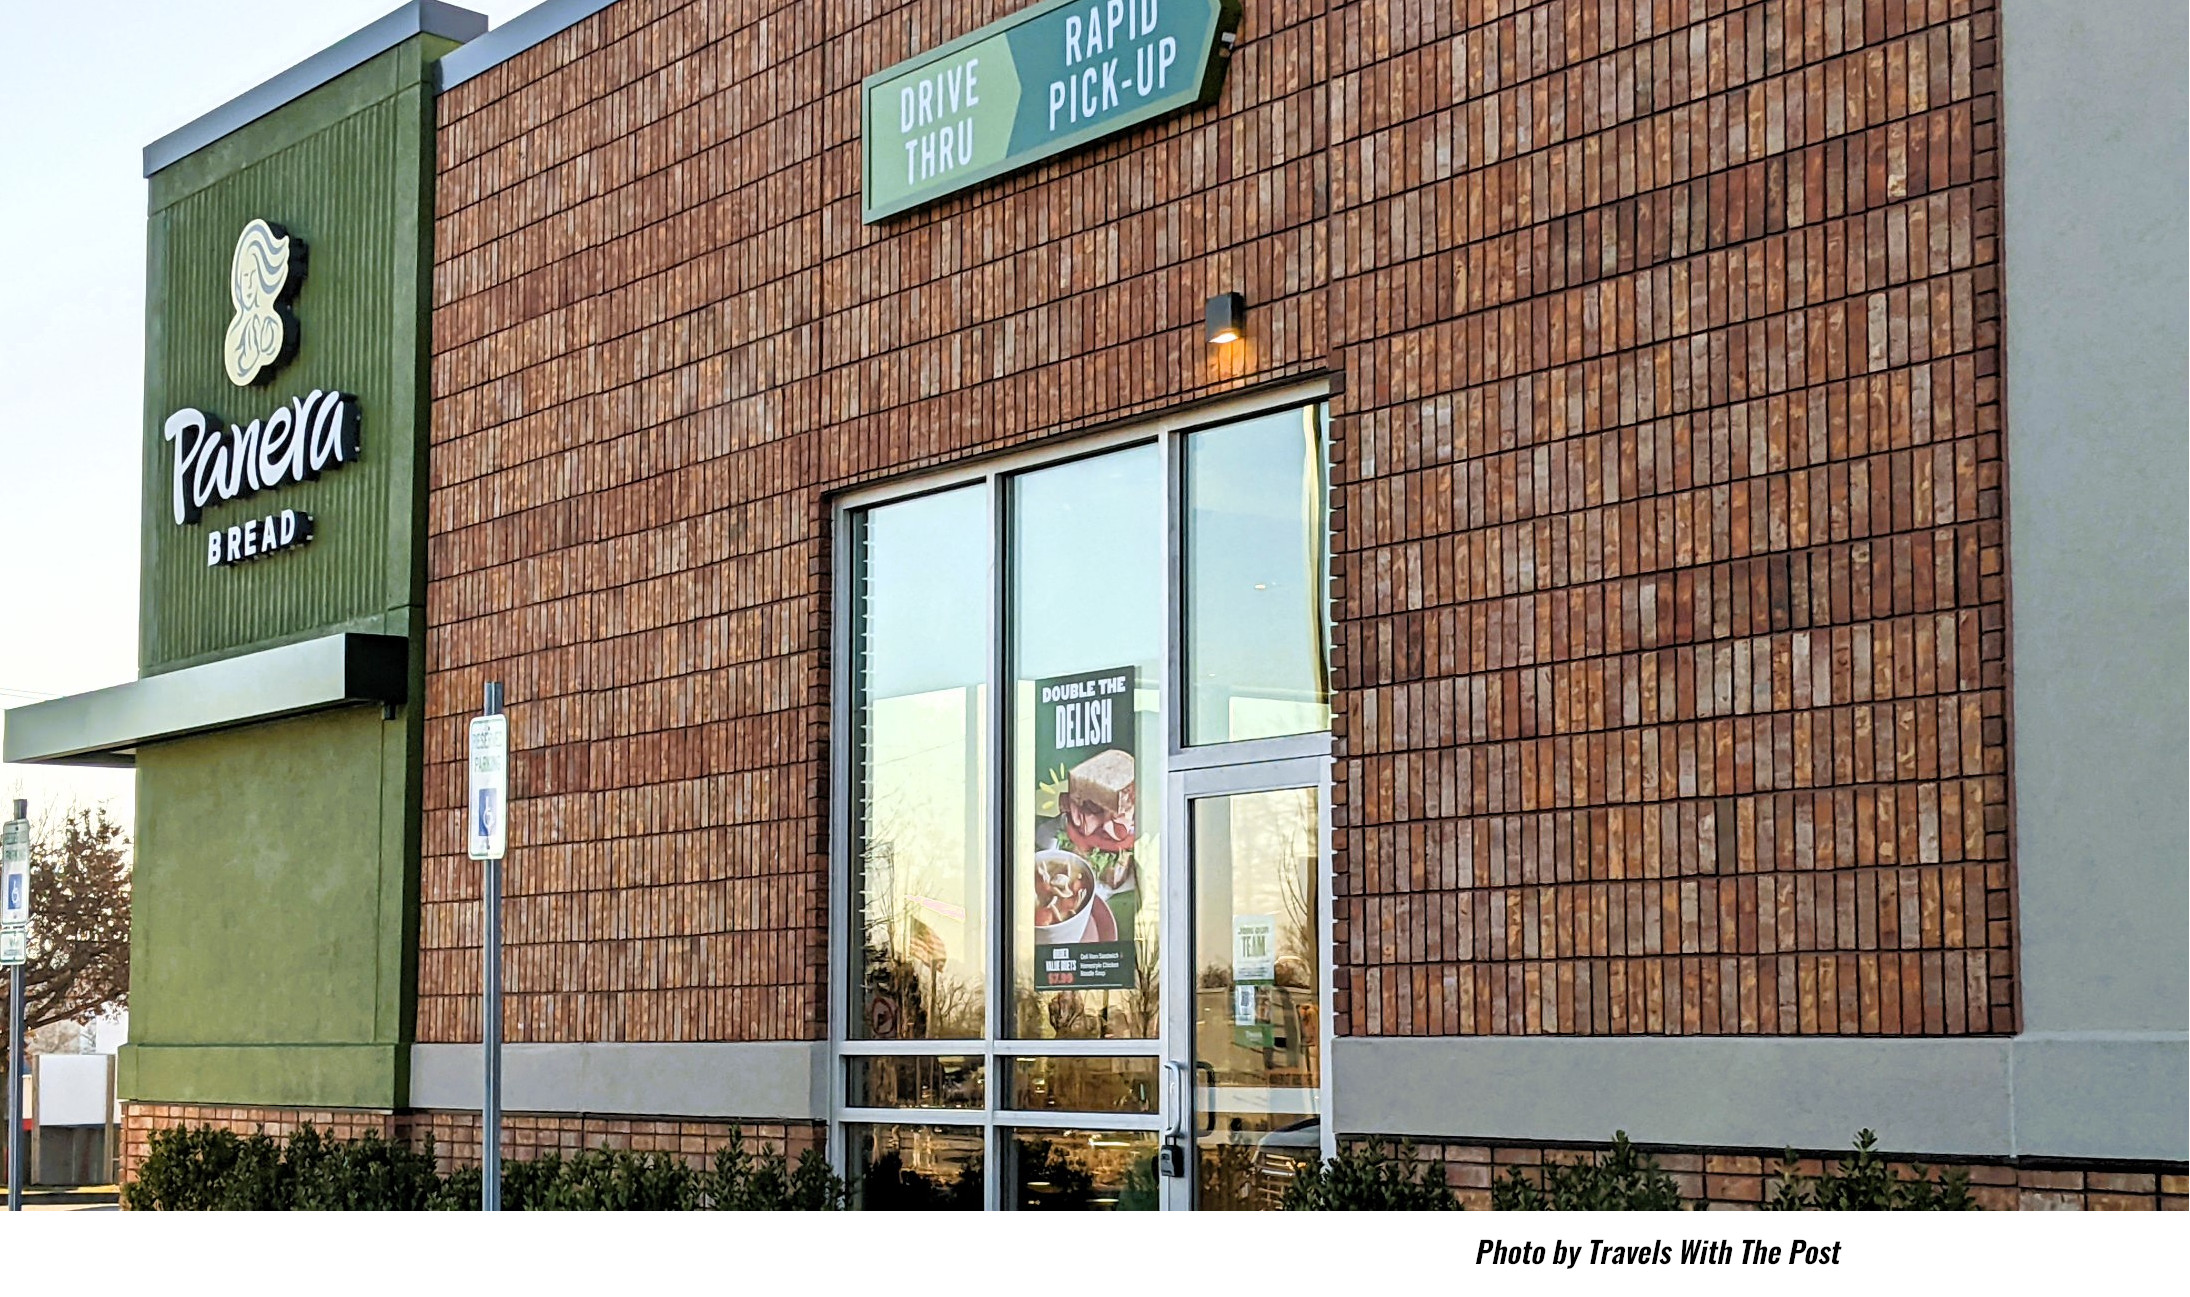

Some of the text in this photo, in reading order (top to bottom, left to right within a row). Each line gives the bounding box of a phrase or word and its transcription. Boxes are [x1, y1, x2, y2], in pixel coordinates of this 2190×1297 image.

[1065, 0, 1158, 66] RAPID
[901, 58, 979, 133] DRIVE
[1049, 36, 1177, 131] PICK-UP
[905, 117, 973, 185] THRU
[164, 389, 344, 525] Panera
[207, 509, 296, 567] BREAD
[1042, 676, 1126, 703] DOUBLE THE
[1055, 698, 1112, 750] DELISH
[1241, 935, 1266, 957] TEAM
